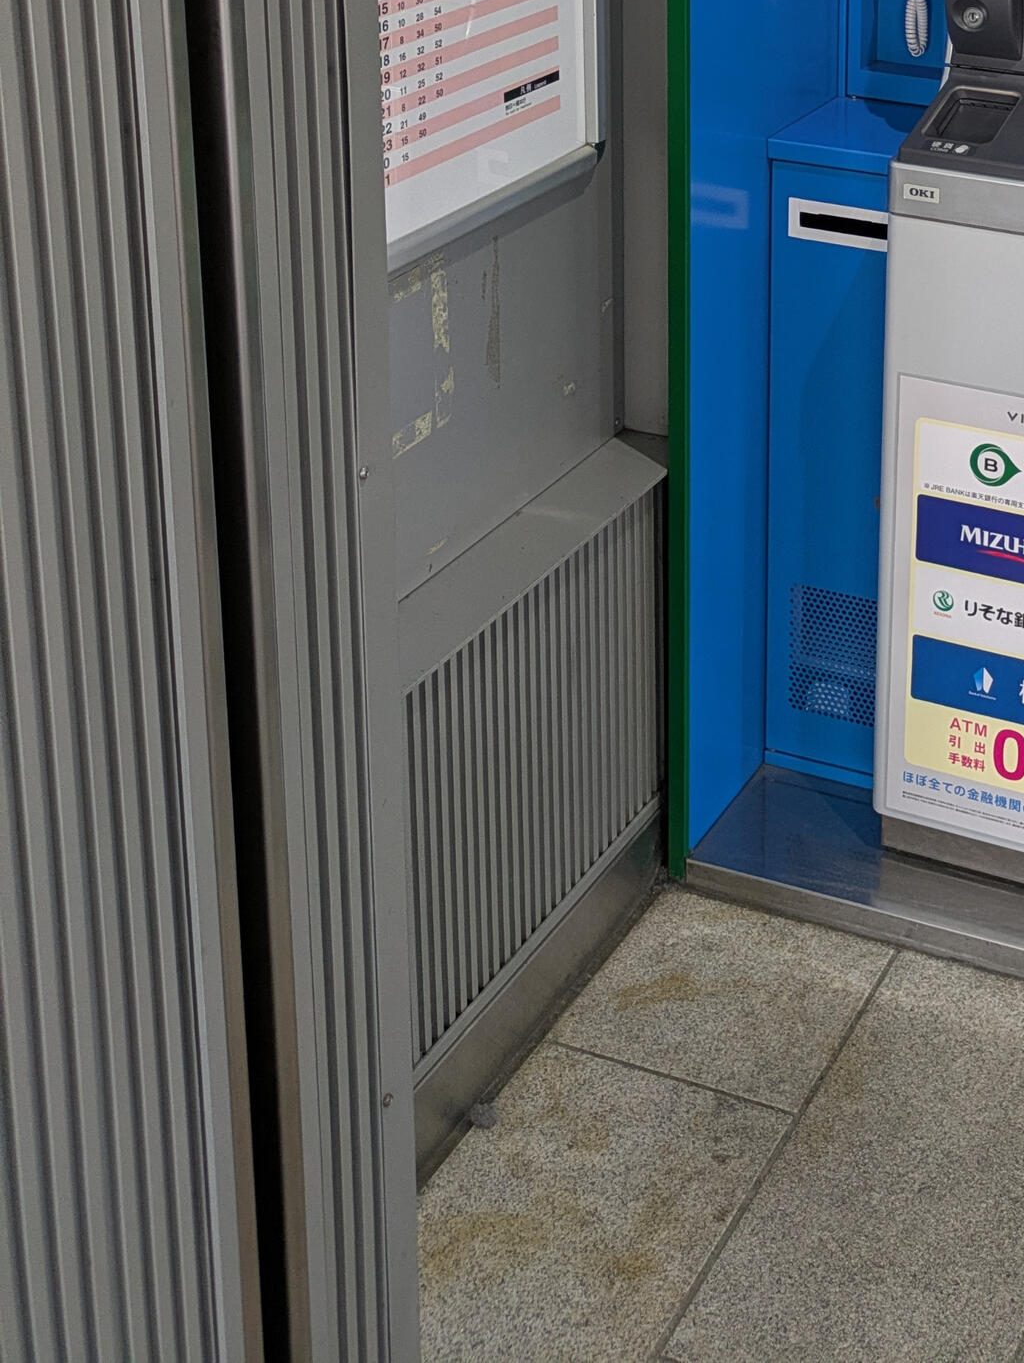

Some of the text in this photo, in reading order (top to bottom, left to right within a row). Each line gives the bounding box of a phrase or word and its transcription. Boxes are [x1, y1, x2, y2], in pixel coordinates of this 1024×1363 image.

[909, 187, 935, 199] OKI
[950, 717, 988, 738] ATM
[948, 752, 986, 773] 手数料
